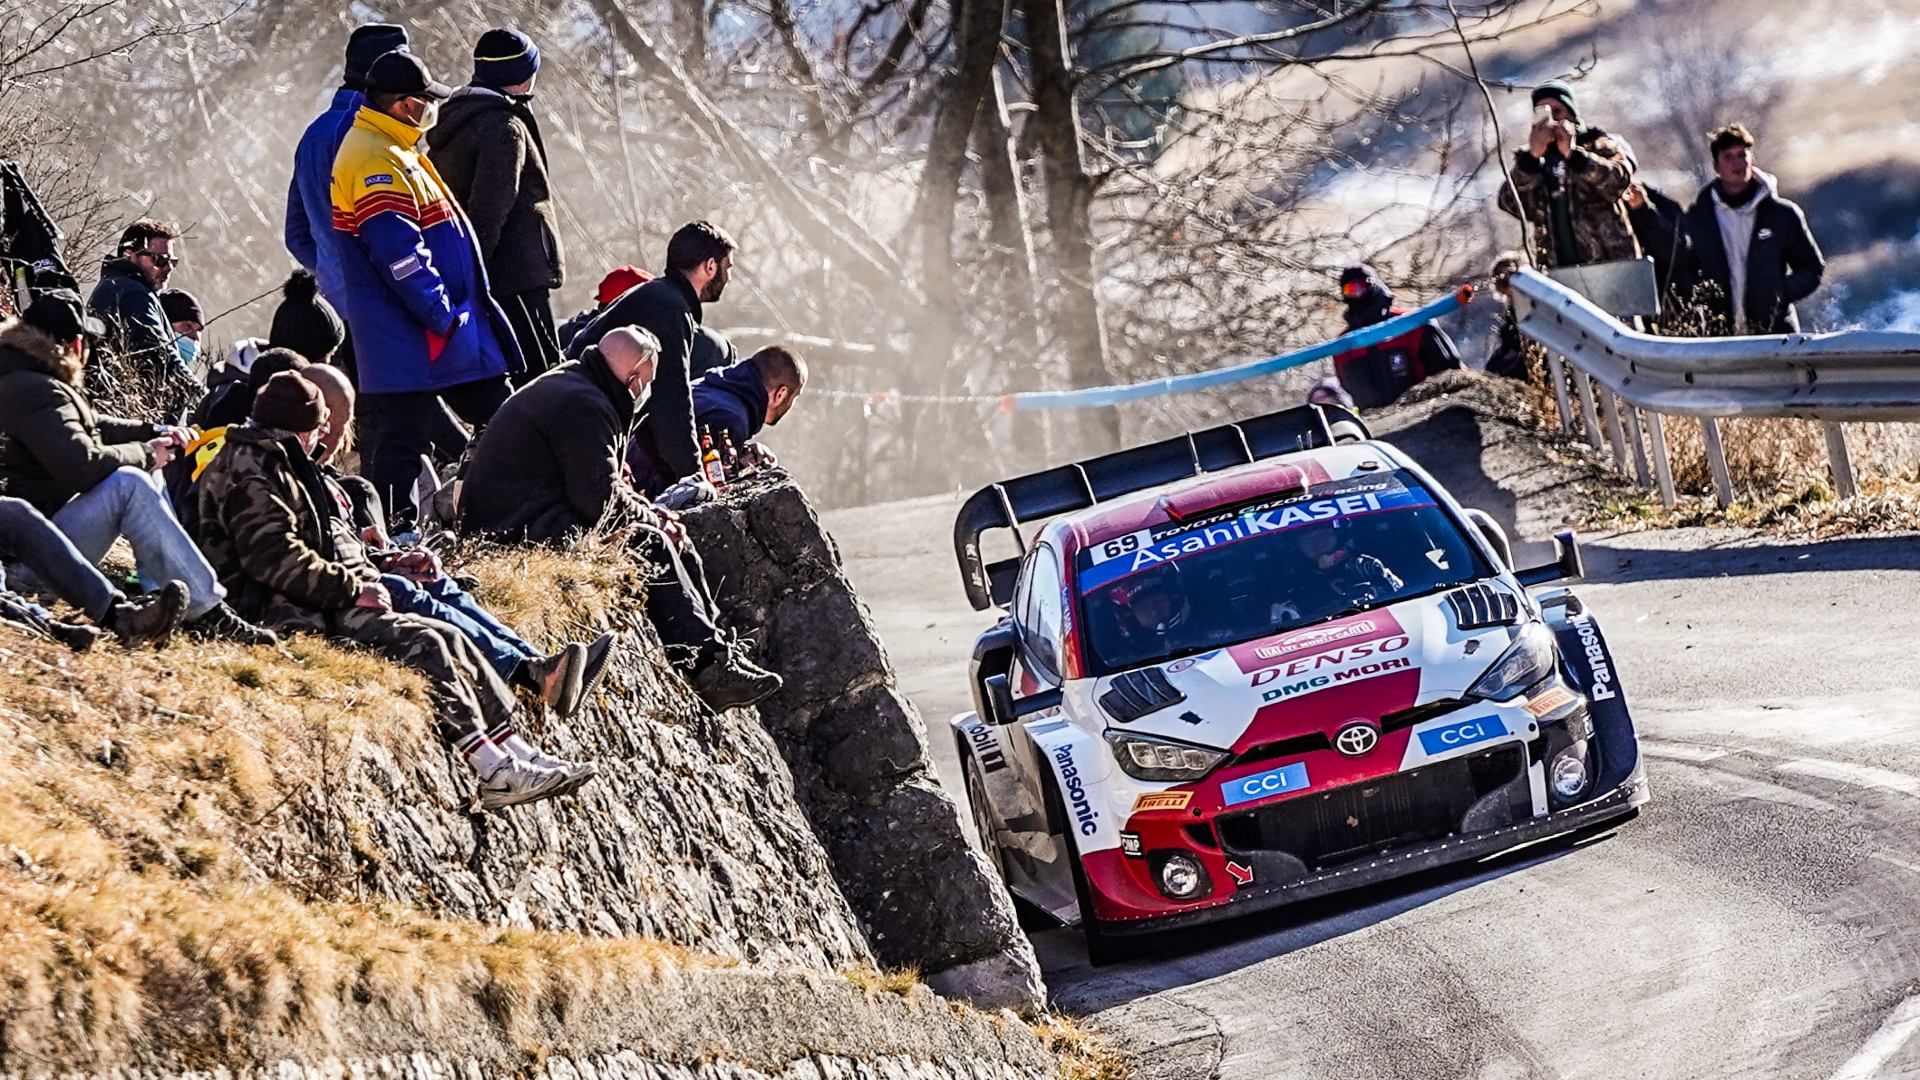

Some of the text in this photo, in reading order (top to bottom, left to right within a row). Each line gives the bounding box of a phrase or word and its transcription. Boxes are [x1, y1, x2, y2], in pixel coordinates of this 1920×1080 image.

[1151, 512, 1233, 540] TOYOTA
[1238, 494, 1313, 515] GAZOO
[1103, 534, 1139, 558] 69
[1251, 637, 1410, 688] DENSO
[1261, 657, 1411, 702] DMG MORI
[969, 725, 999, 752] obil
[1052, 743, 1097, 837] Panasonic
[1135, 793, 1188, 809] PIRELLI
